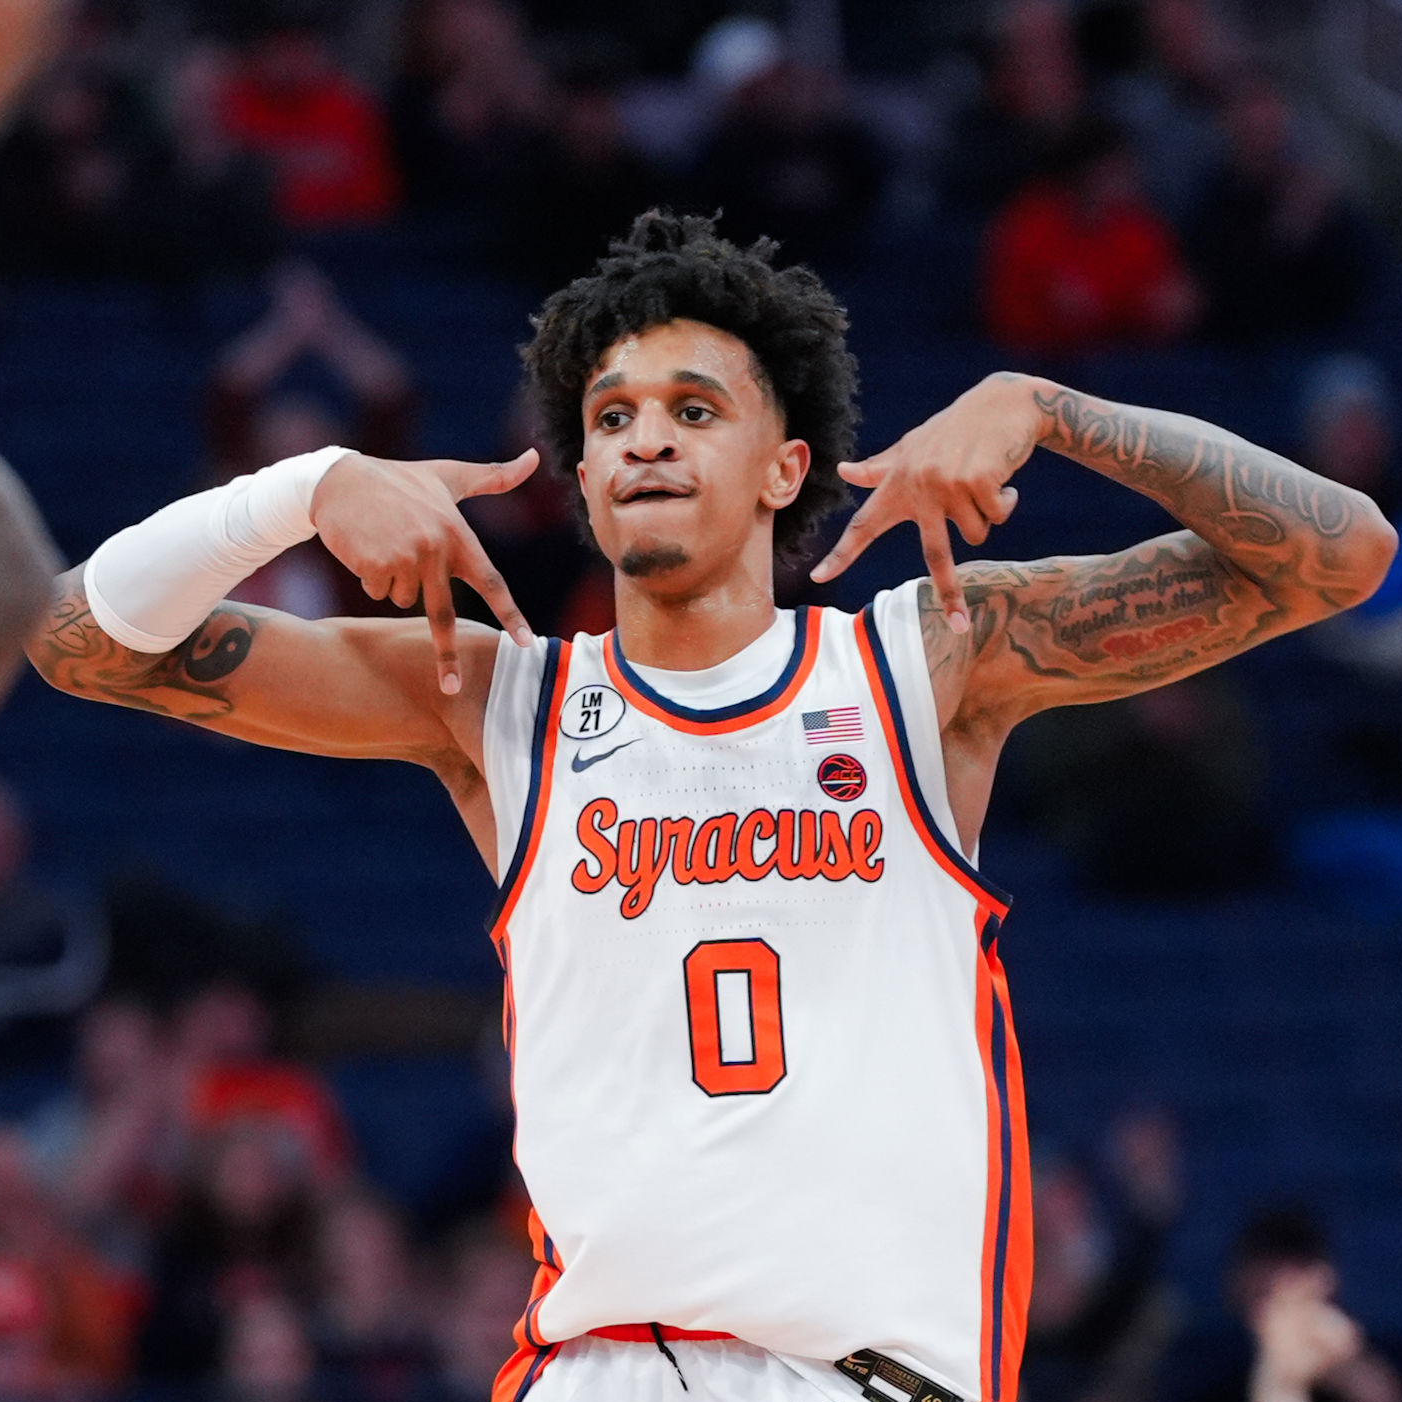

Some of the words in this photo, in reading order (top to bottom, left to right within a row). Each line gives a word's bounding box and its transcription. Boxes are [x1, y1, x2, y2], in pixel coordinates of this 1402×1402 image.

[579, 709, 601, 733] 21
[582, 692, 603, 708] LM
[570, 797, 885, 920] Syracuse
[683, 937, 787, 1098] 0
